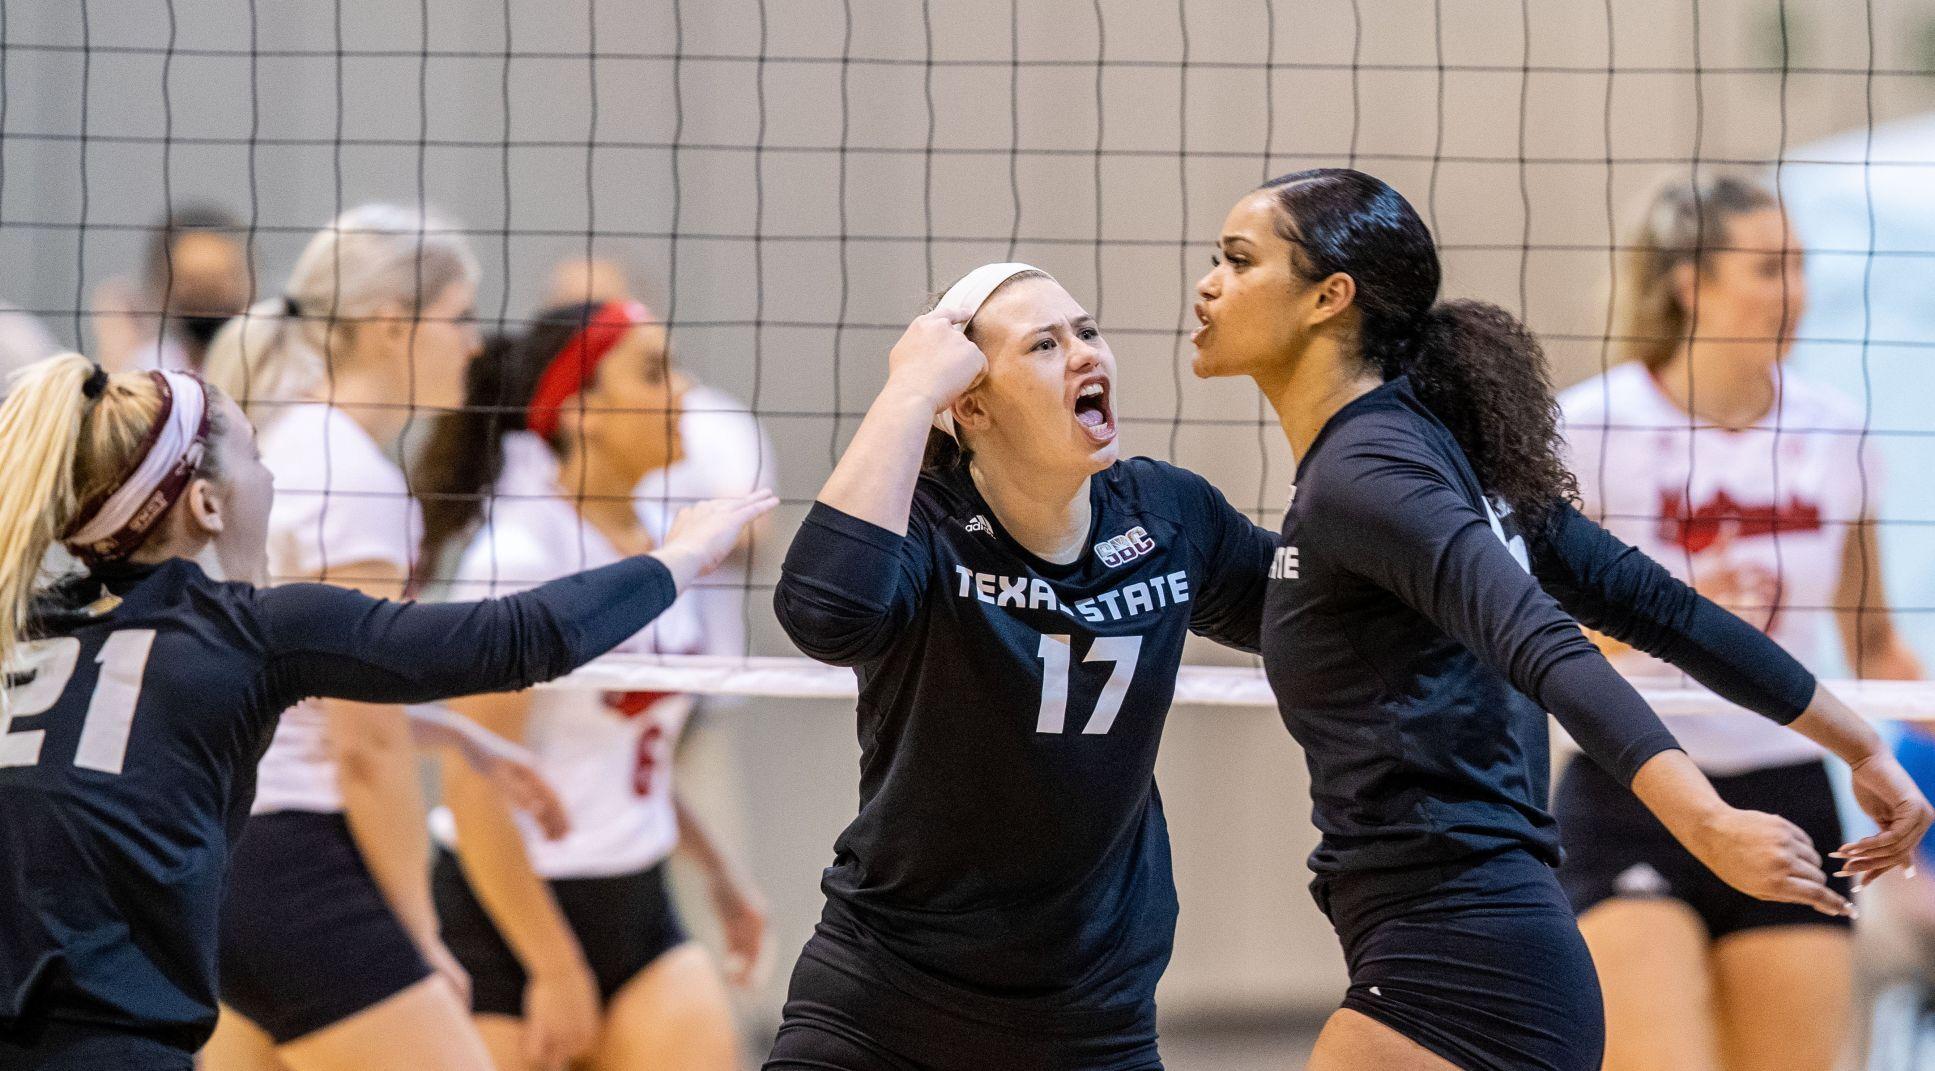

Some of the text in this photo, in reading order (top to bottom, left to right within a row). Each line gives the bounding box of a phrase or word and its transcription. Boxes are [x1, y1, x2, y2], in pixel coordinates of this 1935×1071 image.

[965, 521, 997, 540] adi
[1094, 526, 1156, 568] SBC
[956, 564, 1190, 622] TEXA STATE
[0, 629, 157, 775] 21
[1036, 633, 1143, 735] 17
